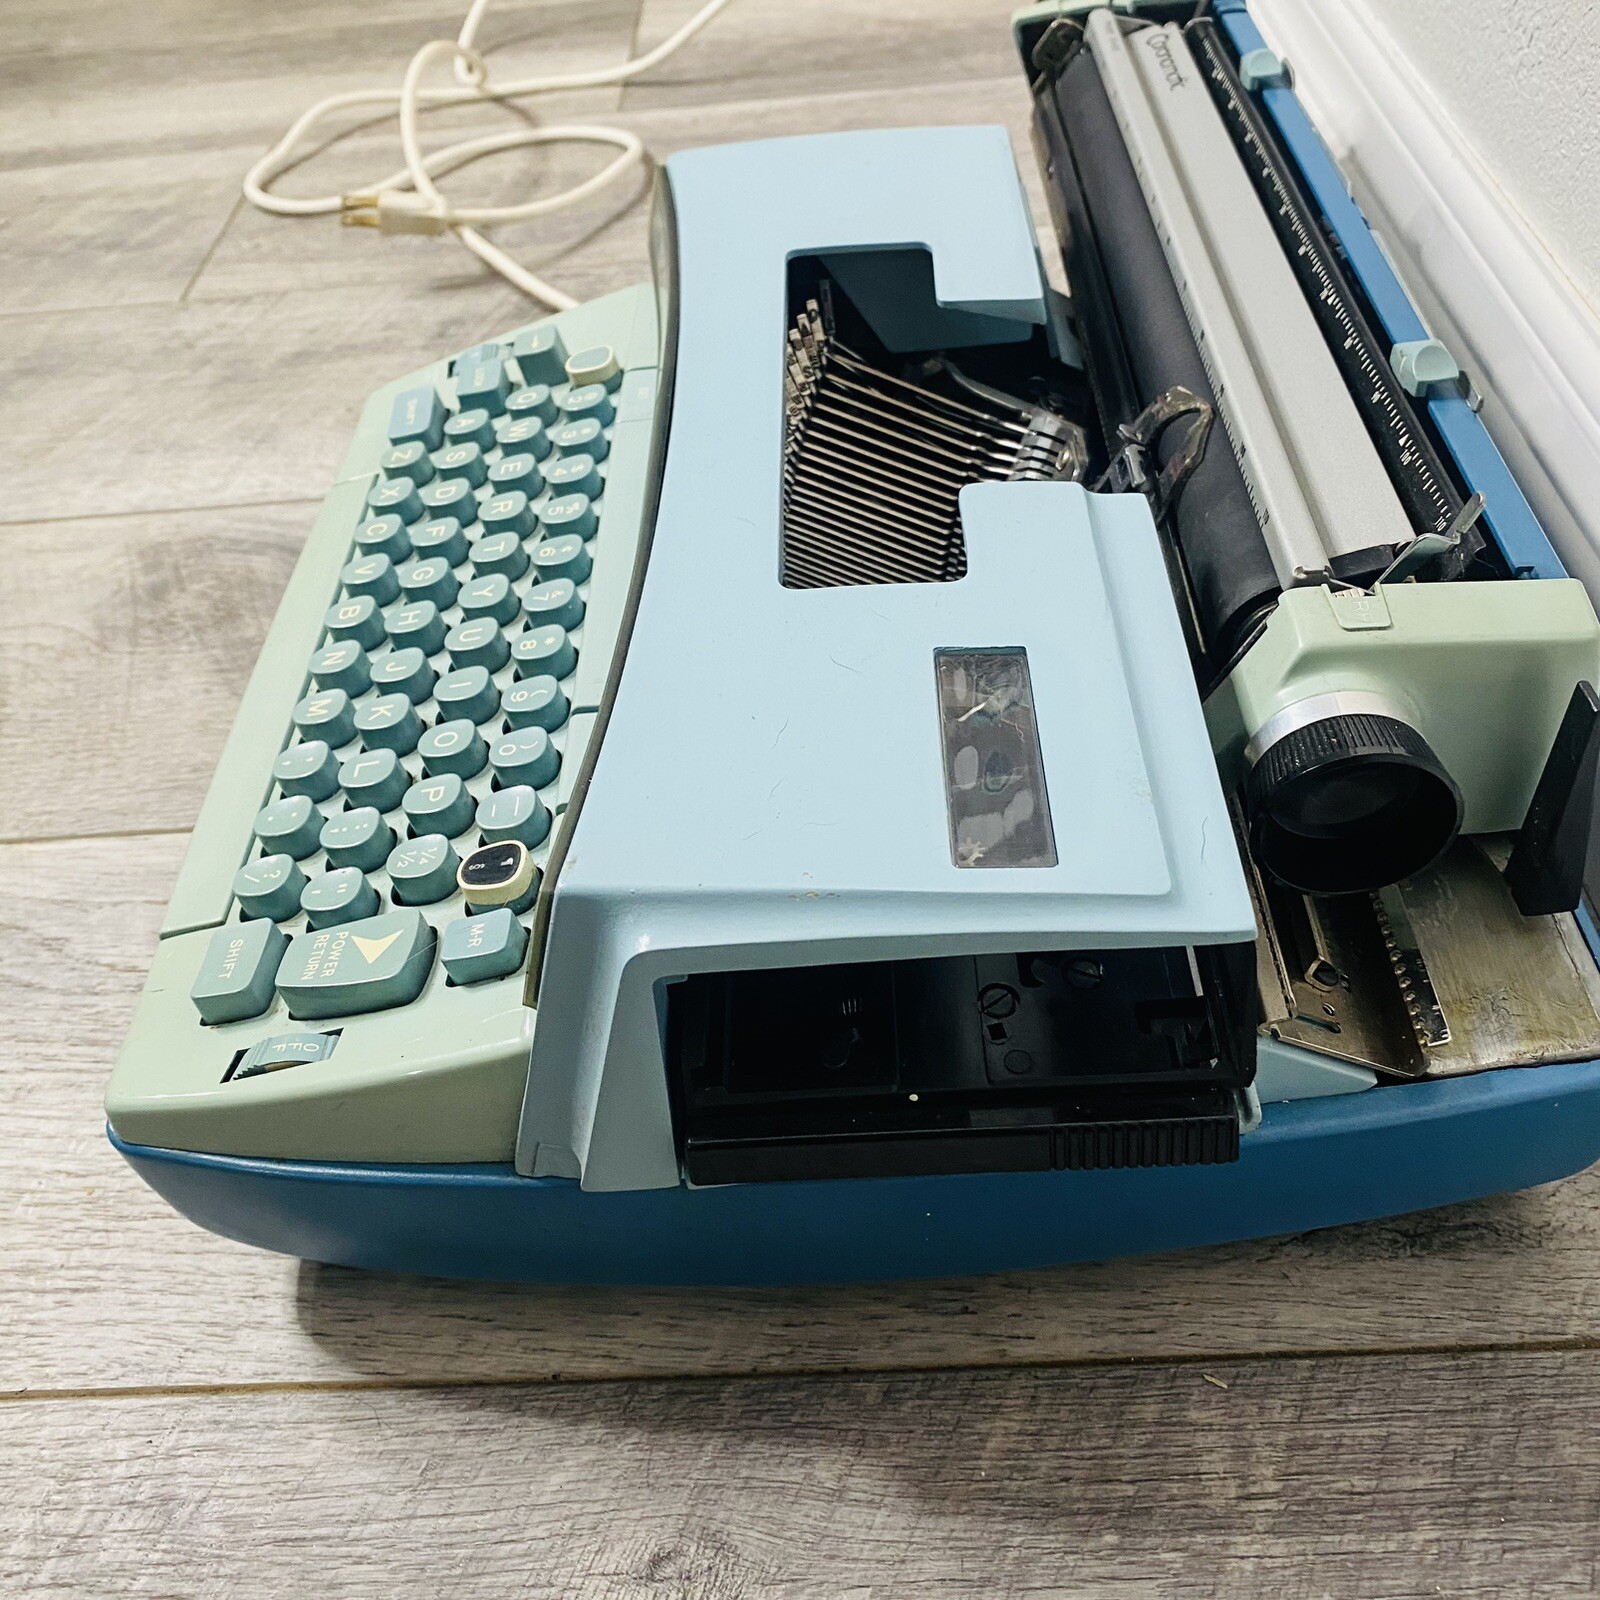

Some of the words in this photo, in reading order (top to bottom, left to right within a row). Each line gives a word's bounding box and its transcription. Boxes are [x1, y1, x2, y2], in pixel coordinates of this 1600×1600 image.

[457, 418, 475, 428] A
[508, 423, 528, 438] W
[390, 450, 412, 462] Z
[446, 451, 466, 462] S
[1398, 450, 1412, 466] 100
[501, 461, 521, 474] E
[553, 467, 567, 477] 4
[381, 486, 399, 497] X
[436, 487, 455, 498] D
[492, 500, 512, 513] R
[548, 506, 564, 515] 5
[366, 523, 387, 535] C
[1434, 516, 1447, 532] 110
[425, 526, 446, 538] F
[484, 541, 505, 552] T
[539, 549, 555, 557] 6
[355, 563, 375, 575] V
[412, 567, 434, 580] G
[472, 585, 493, 597] Y
[533, 592, 549, 601] 7
[339, 606, 361, 618] B
[398, 610, 421, 626] H
[459, 628, 483, 642] U
[520, 639, 537, 650] 8
[321, 651, 346, 665] N
[386, 662, 406, 672] J
[510, 691, 529, 703] 9
[306, 700, 332, 718] M
[368, 705, 392, 720] K
[433, 731, 459, 747] O
[353, 760, 380, 777] L
[421, 786, 445, 802] P
[263, 870, 282, 880] ?
[466, 924, 486, 947] M-R
[217, 938, 244, 979] SHIFT
[301, 933, 331, 980] RETURN
[321, 932, 350, 977] POWER
[272, 1041, 320, 1053] OFF
